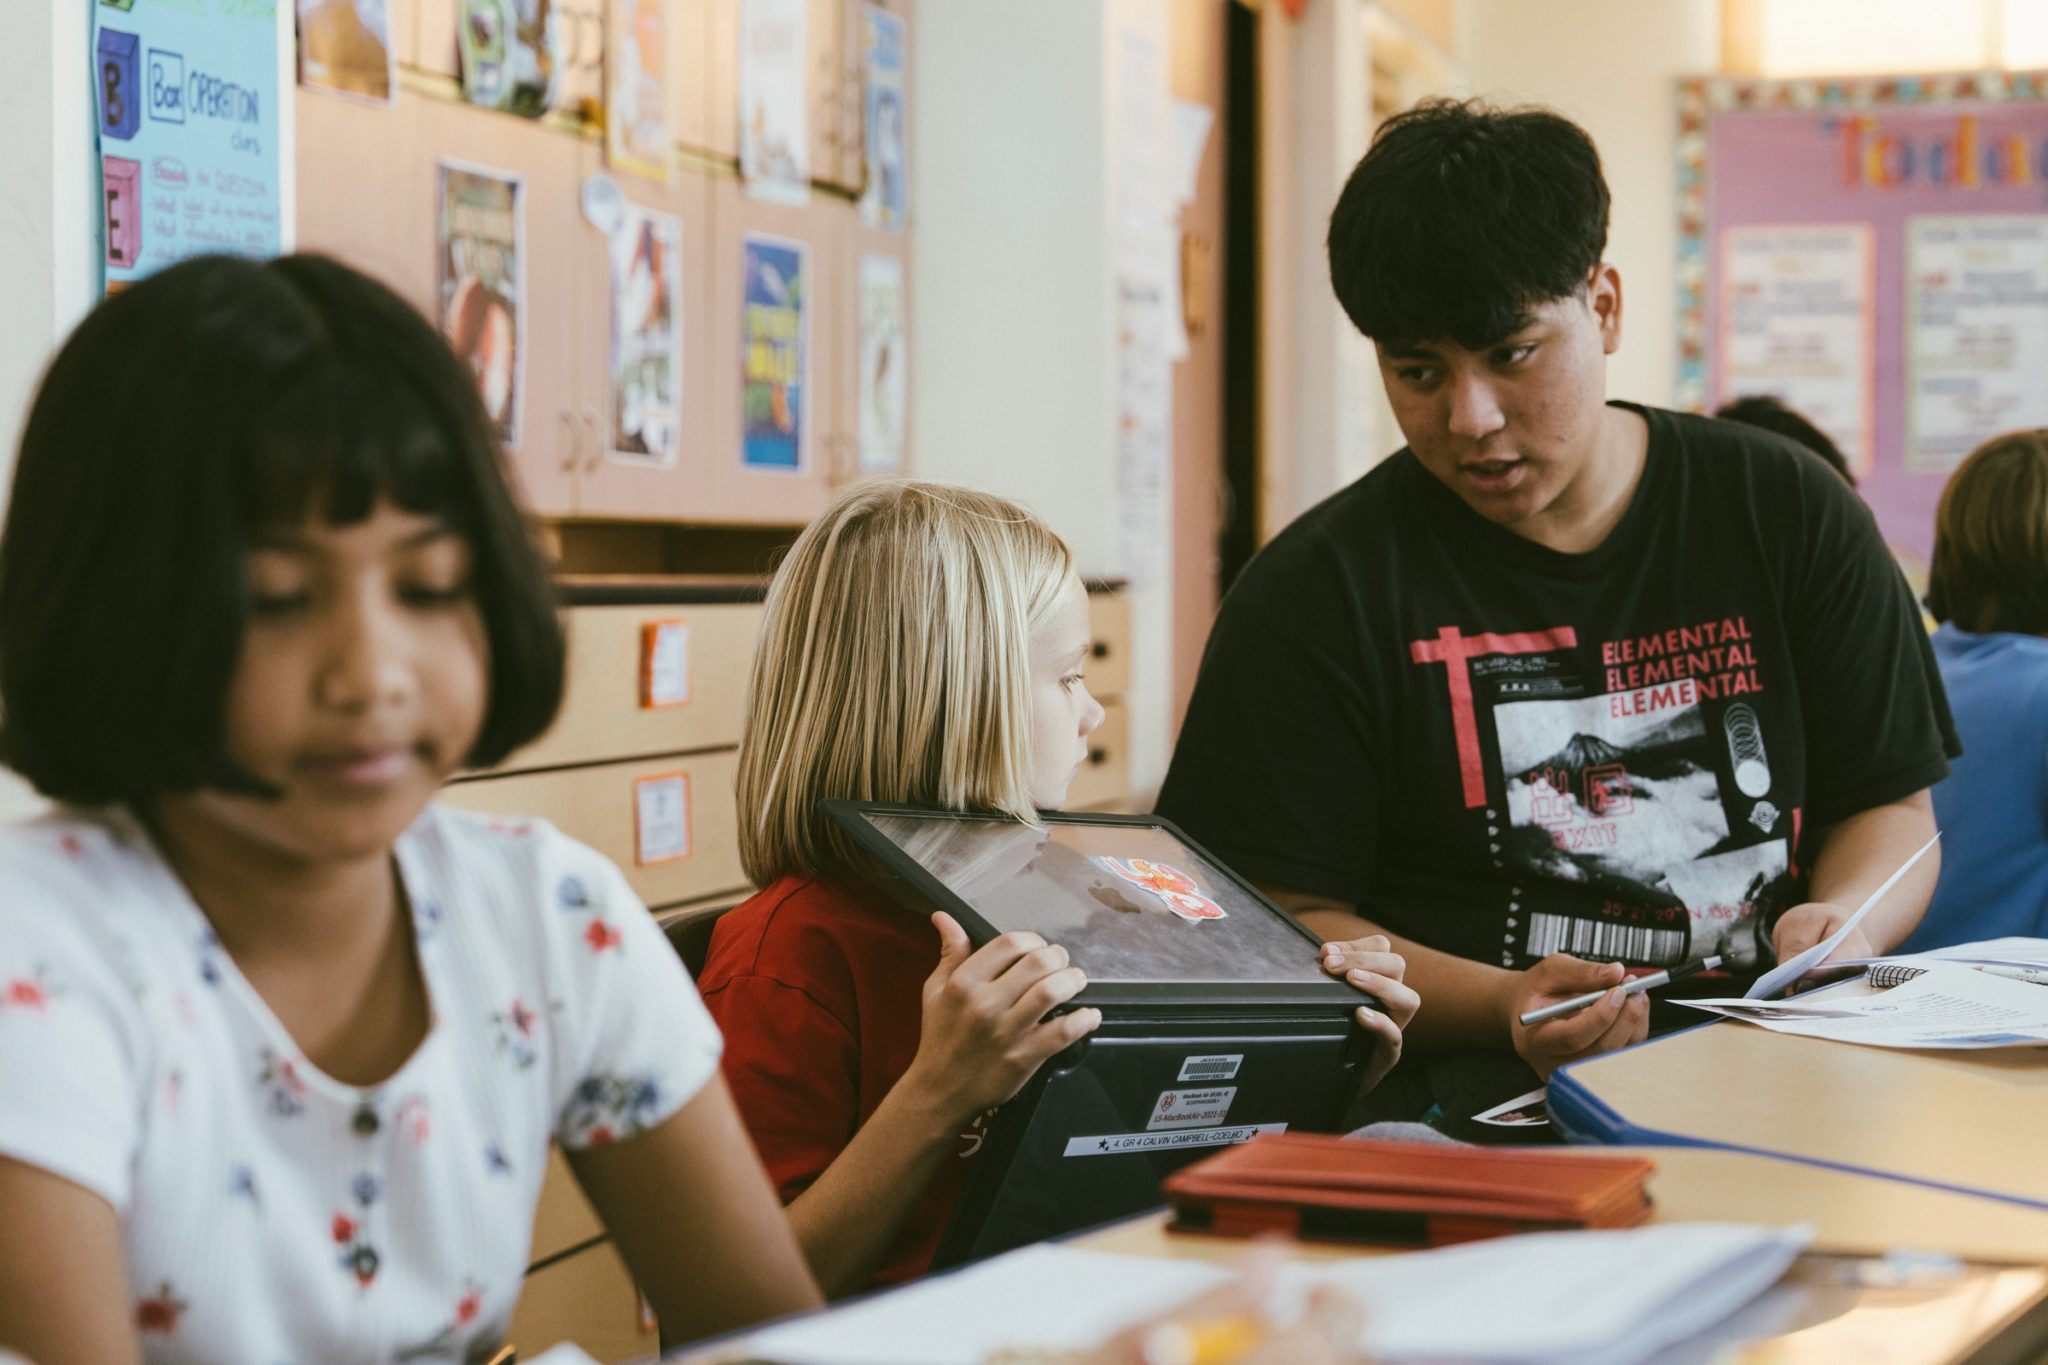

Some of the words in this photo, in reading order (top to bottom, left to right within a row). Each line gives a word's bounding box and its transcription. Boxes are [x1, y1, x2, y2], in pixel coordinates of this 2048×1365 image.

[152, 62, 181, 108] Box
[188, 70, 259, 124] OPERATION
[1601, 616, 1752, 666] ELEMENTAL
[1606, 642, 1757, 692] ELEMENTAL
[1610, 669, 1763, 718] ELEMENTAL
[1551, 823, 1617, 852] EXIT
[1123, 1139, 1136, 1148] GR
[1136, 1138, 1142, 1146] 4
[1143, 1136, 1170, 1146] CALVIN
[1172, 1130, 1244, 1144] CAMPBELL-COELHO
